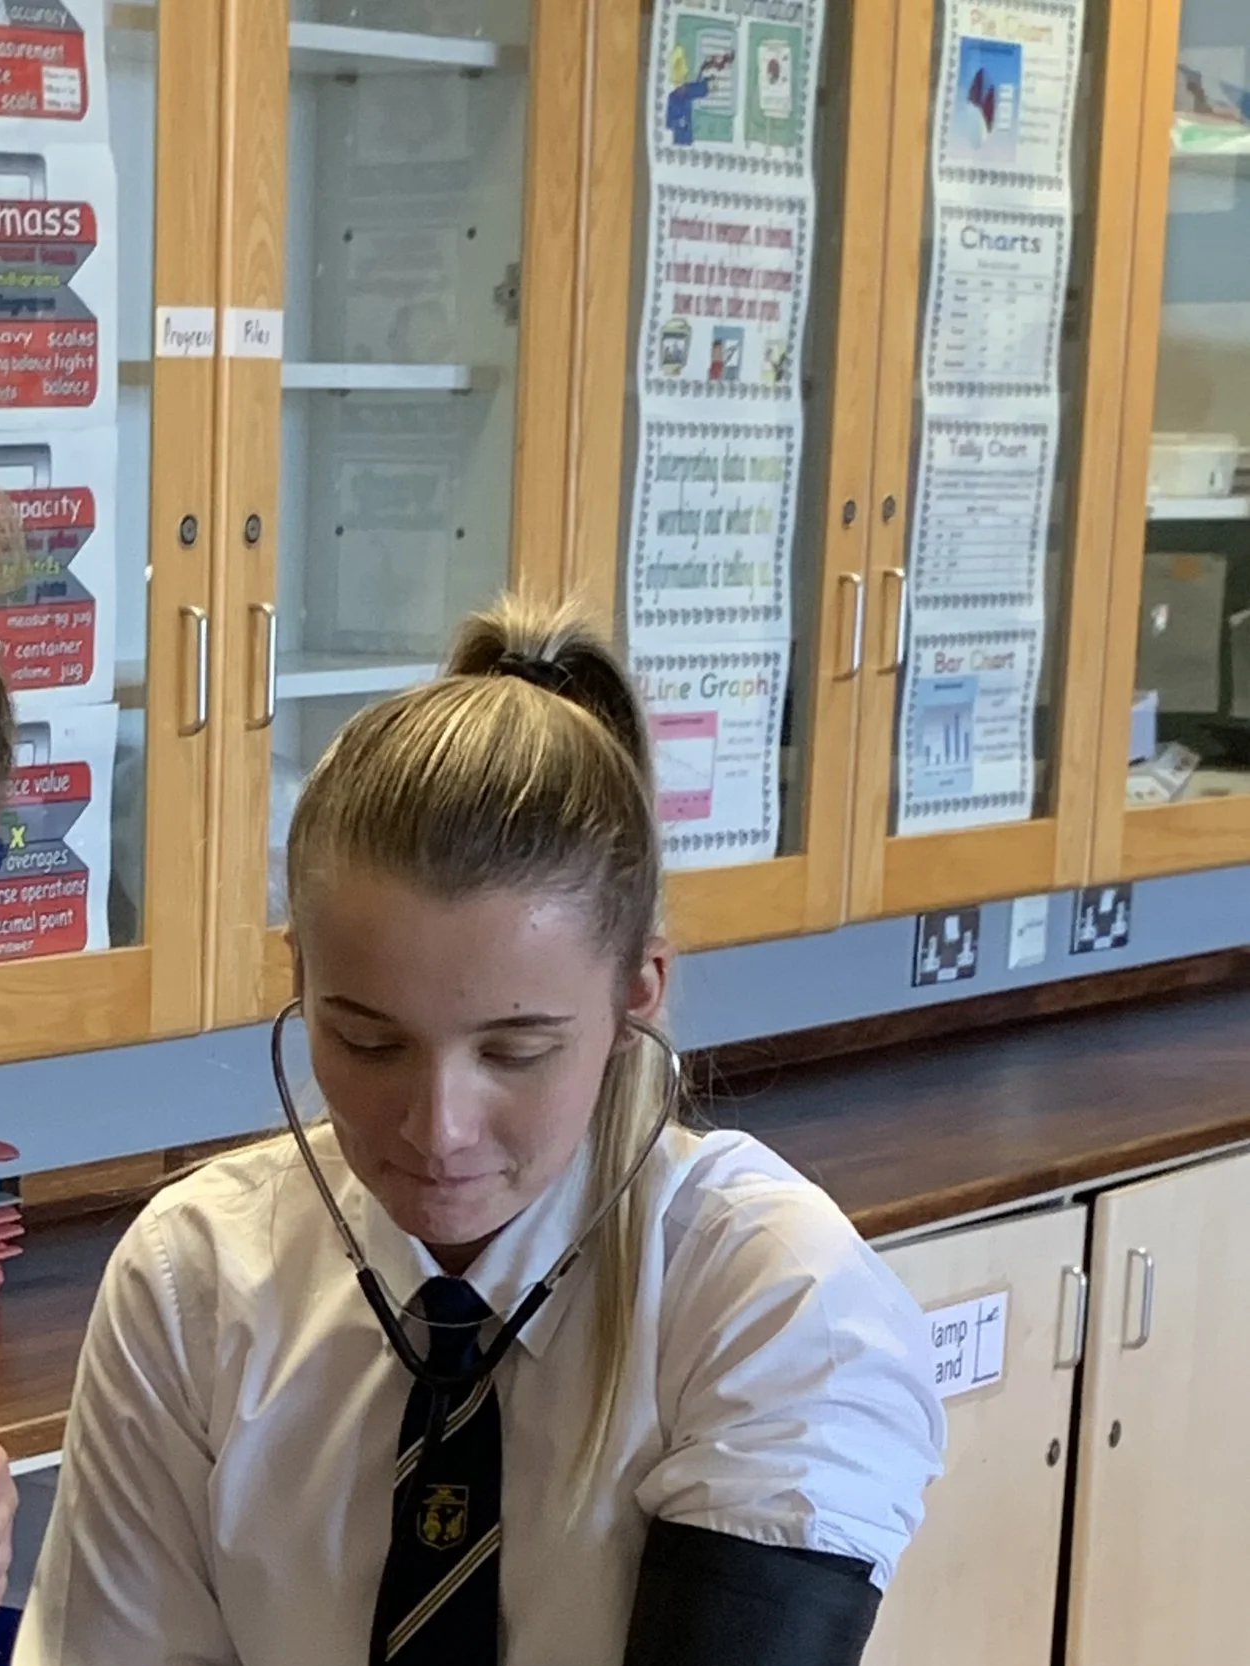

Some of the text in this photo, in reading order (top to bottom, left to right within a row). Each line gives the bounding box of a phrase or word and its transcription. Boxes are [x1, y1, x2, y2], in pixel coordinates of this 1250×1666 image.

[1, 91, 38, 111] scale
[960, 225, 1042, 254] Charts
[47, 328, 94, 347] scales
[244, 318, 270, 345] Files
[55, 353, 94, 375] light
[15, 640, 83, 659] container
[934, 651, 965, 674] Bar
[700, 671, 768, 706] Graph
[34, 770, 70, 794] value
[6, 850, 68, 871] averages
[21, 877, 86, 907] operations
[39, 907, 73, 934] point
